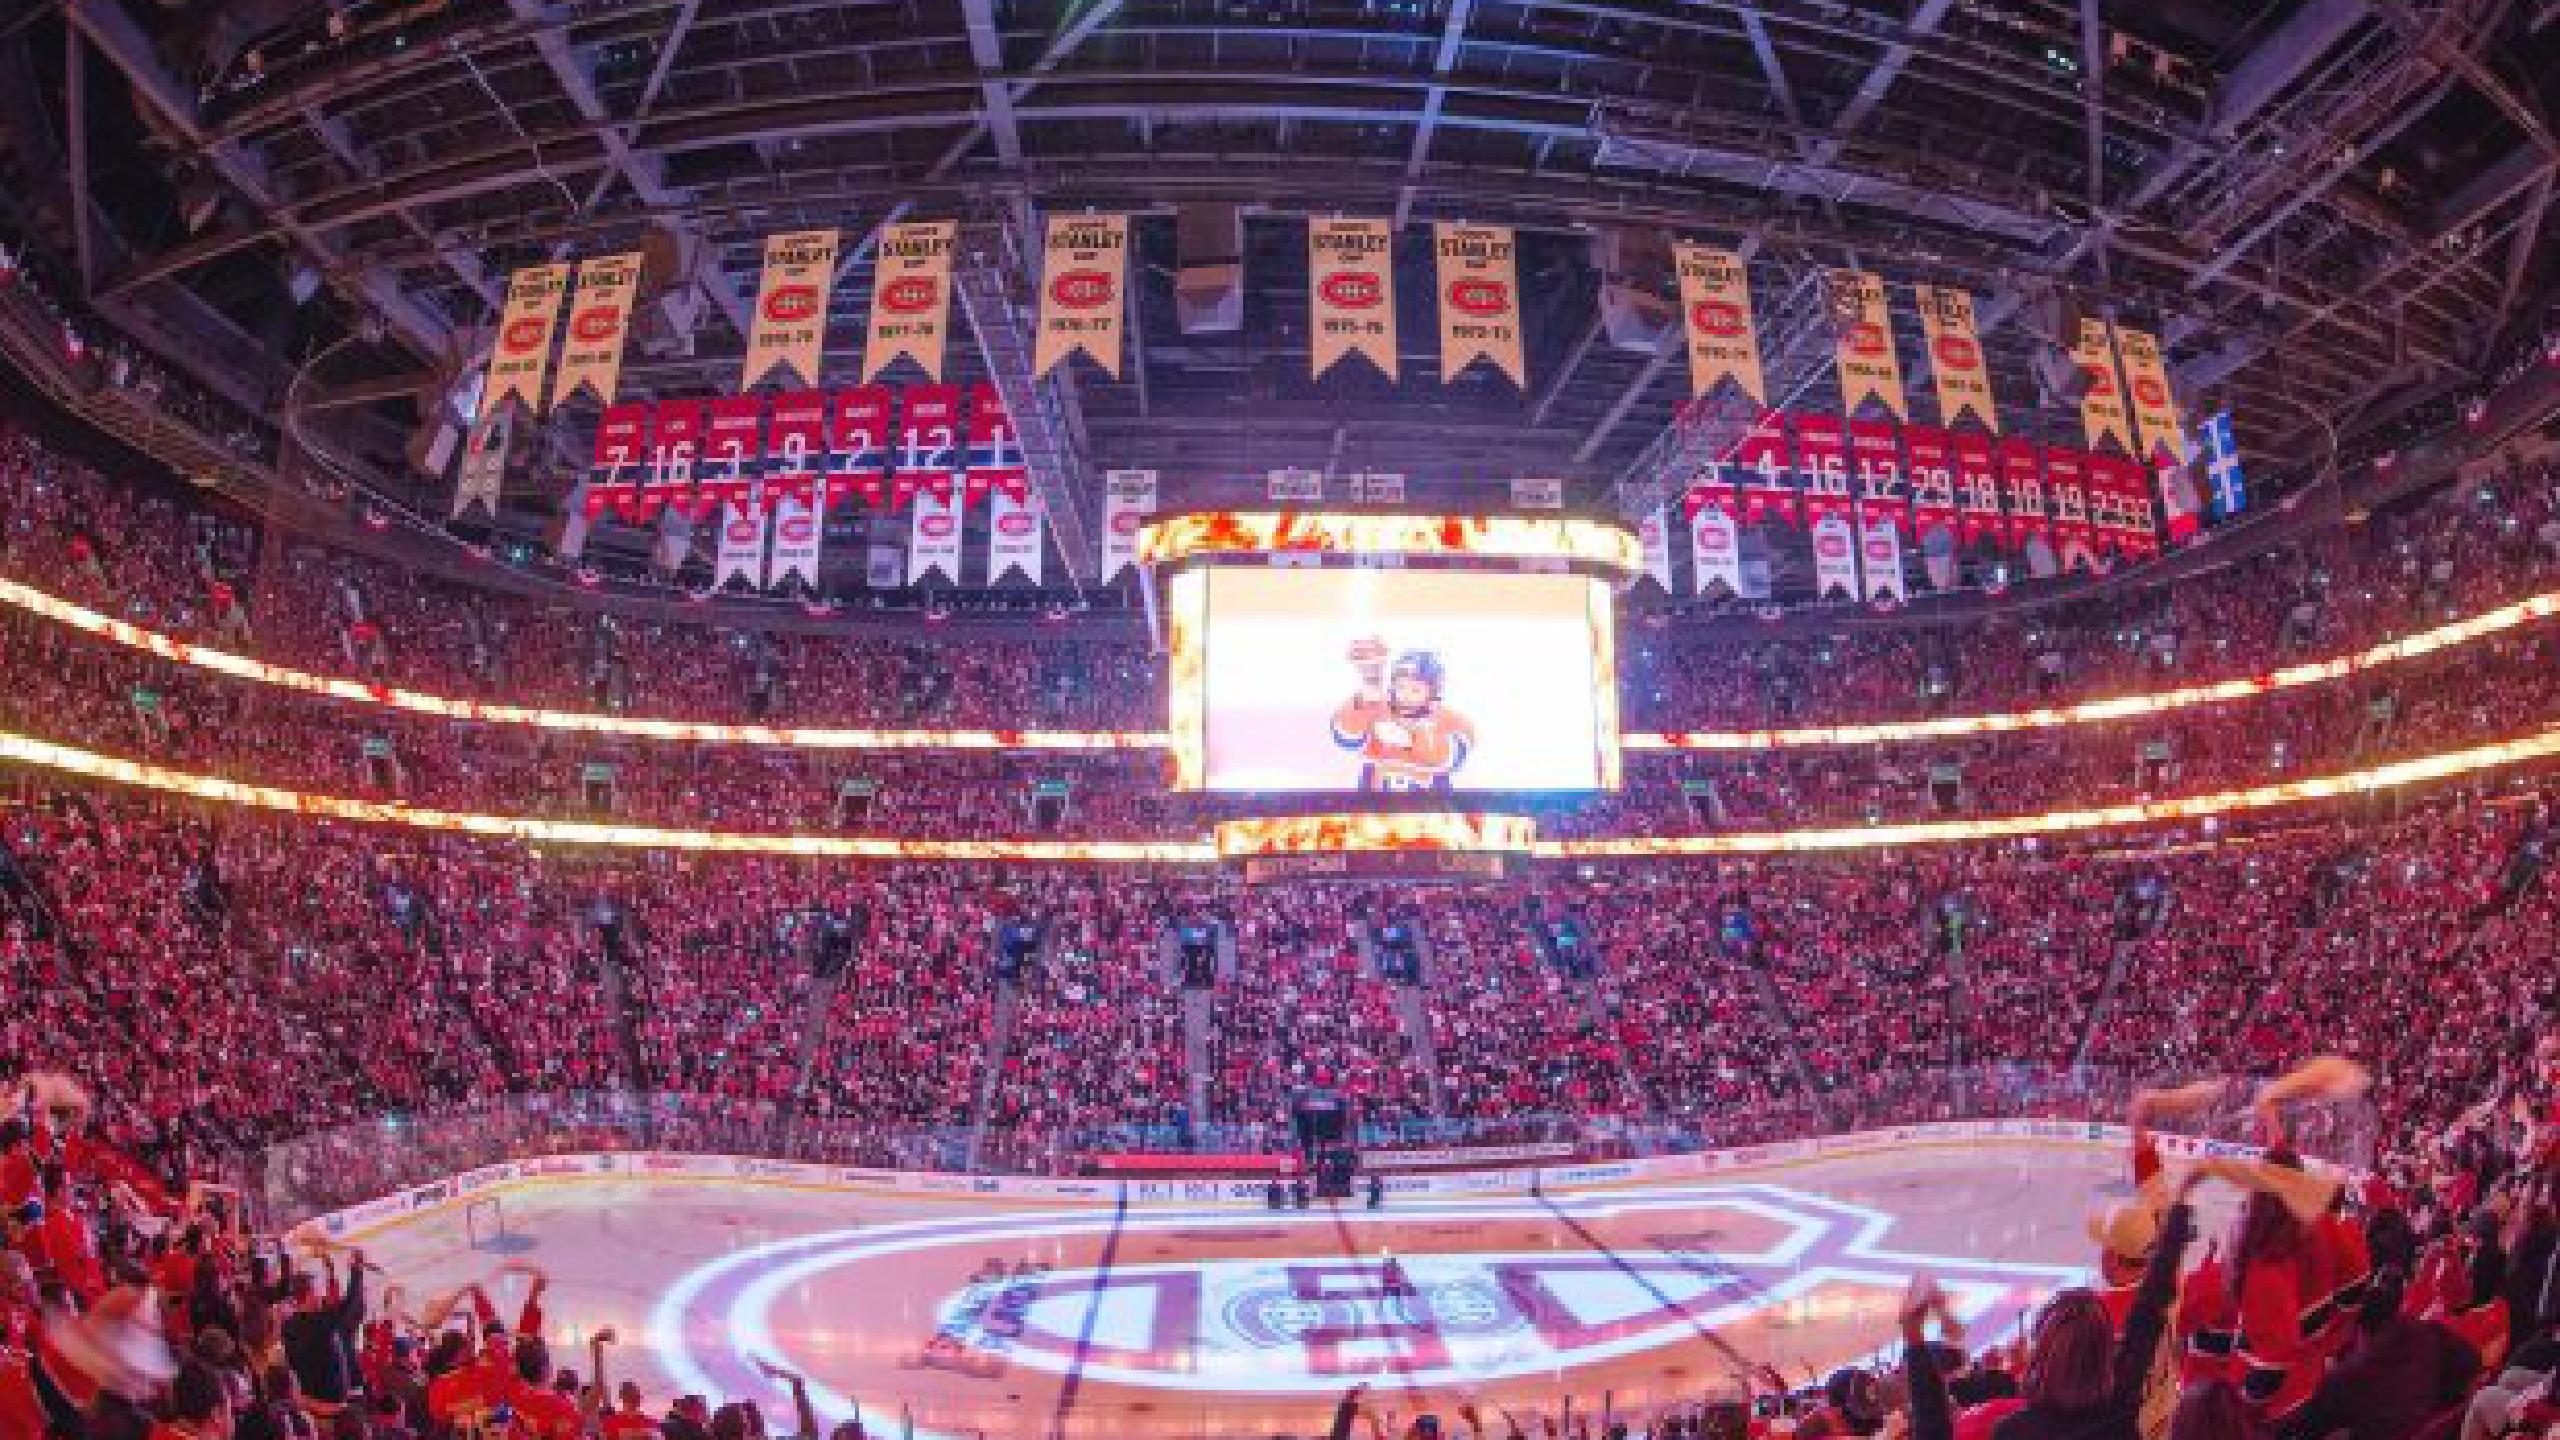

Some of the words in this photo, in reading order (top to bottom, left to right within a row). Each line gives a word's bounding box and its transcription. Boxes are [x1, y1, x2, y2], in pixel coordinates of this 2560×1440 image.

[1049, 232, 1124, 252] STANLEY
[1313, 235, 1389, 253] STANLEY
[1439, 240, 1513, 260] STANLEY
[606, 445, 629, 487] 7
[651, 440, 694, 487] 16
[718, 438, 743, 483] 3
[779, 431, 806, 476] 9
[842, 427, 872, 471] 2
[903, 424, 954, 470] 12
[990, 423, 1005, 468] 1
[1757, 448, 1782, 489] 4
[1806, 452, 1849, 496] 16
[1857, 459, 1900, 501] 12
[1911, 465, 1953, 509] 29
[1959, 472, 1999, 513] 18
[2006, 477, 2044, 515] 10
[2052, 482, 2086, 522] 19
